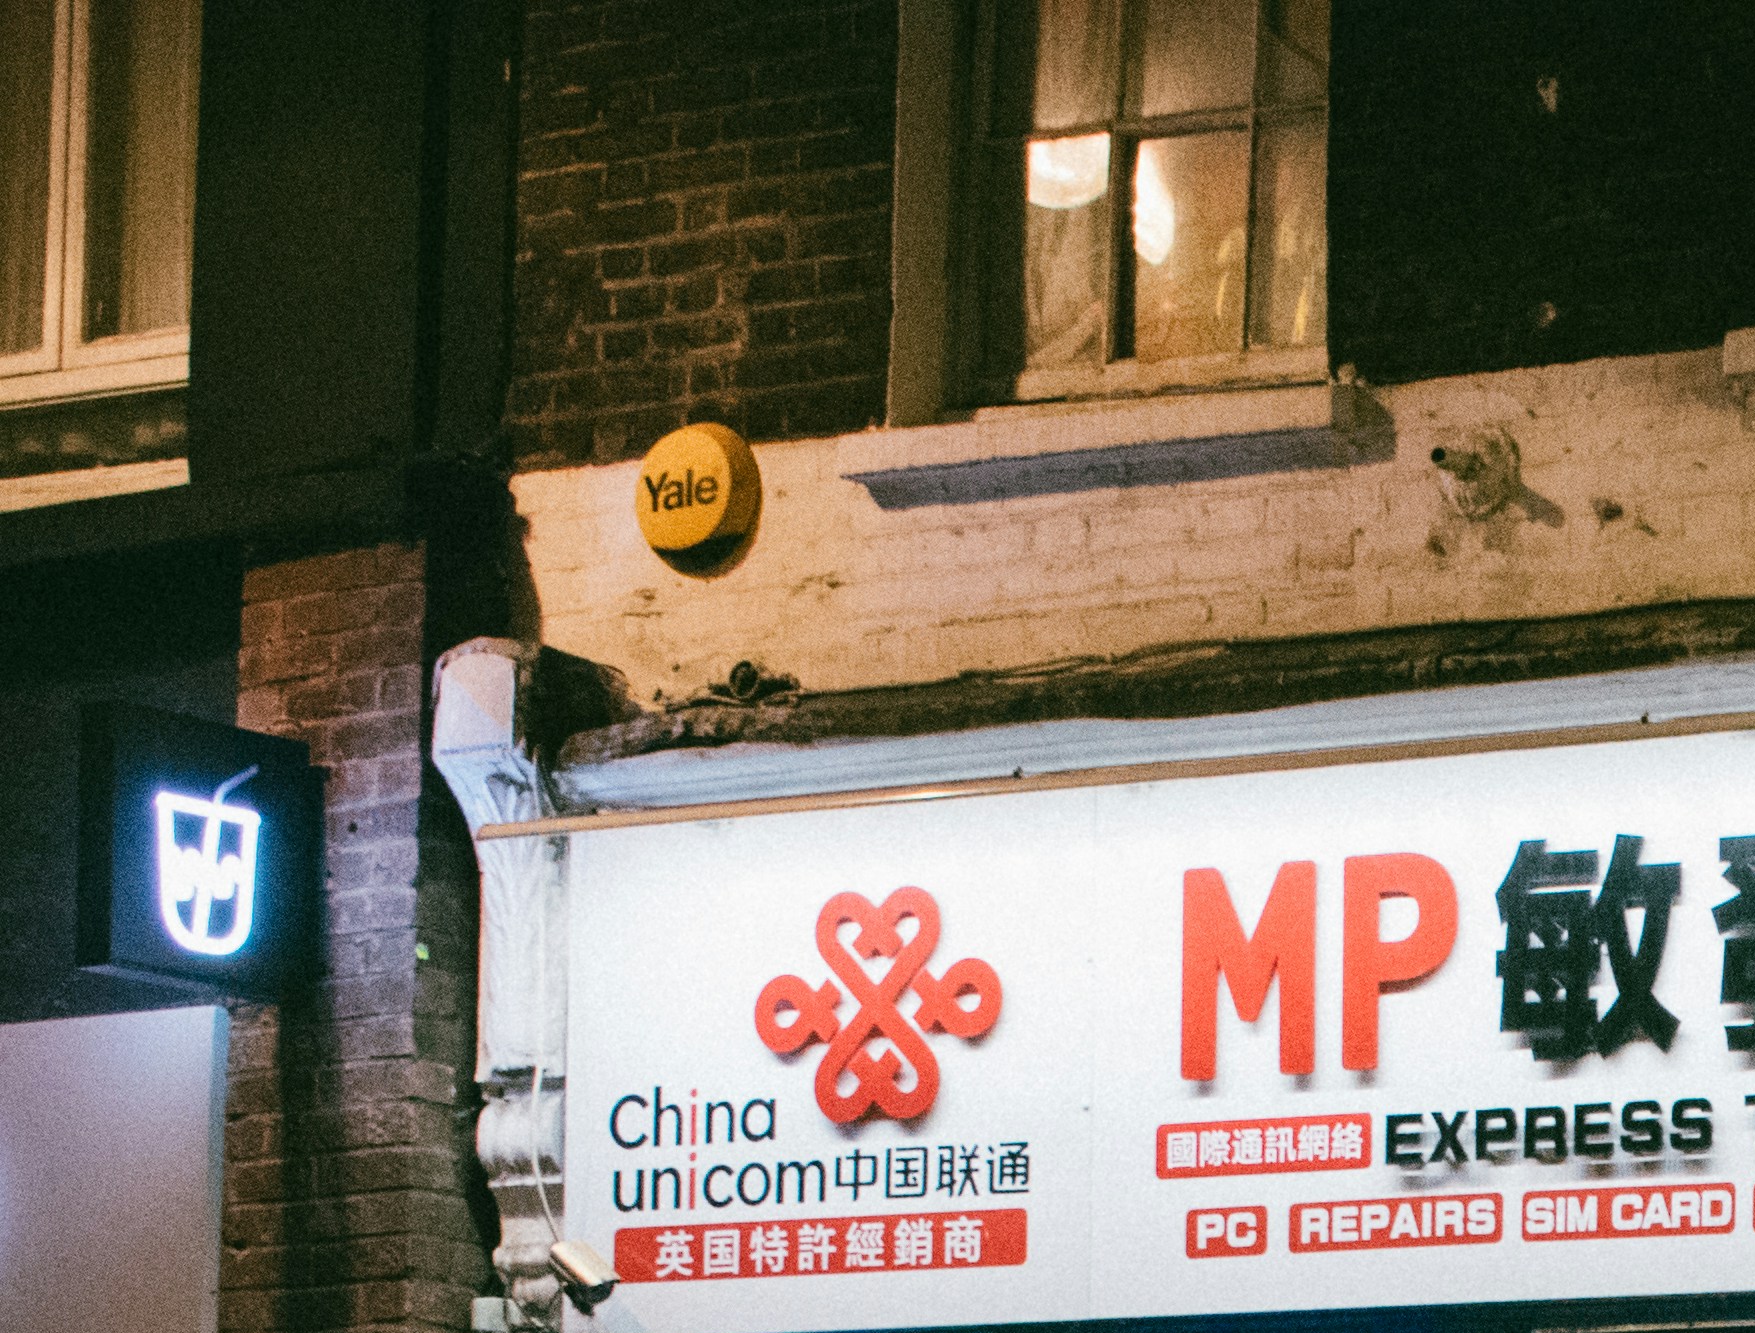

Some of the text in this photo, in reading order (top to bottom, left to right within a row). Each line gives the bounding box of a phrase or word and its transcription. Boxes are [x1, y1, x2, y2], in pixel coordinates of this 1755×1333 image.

[645, 469, 719, 514] Yale
[1181, 853, 1459, 1081] MP
[608, 1085, 777, 1149] China
[1165, 1122, 1364, 1170] 國際通訊網絡
[1385, 1097, 1715, 1165] EXPRESS
[612, 1142, 1031, 1212] unicom 中国联通
[655, 1215, 984, 1278] 英国特許經銷商
[1196, 1211, 1257, 1250] PC
[1299, 1198, 1496, 1244] REPAIRS
[1525, 1196, 1598, 1235] SIM
[1611, 1189, 1734, 1233] CARD
